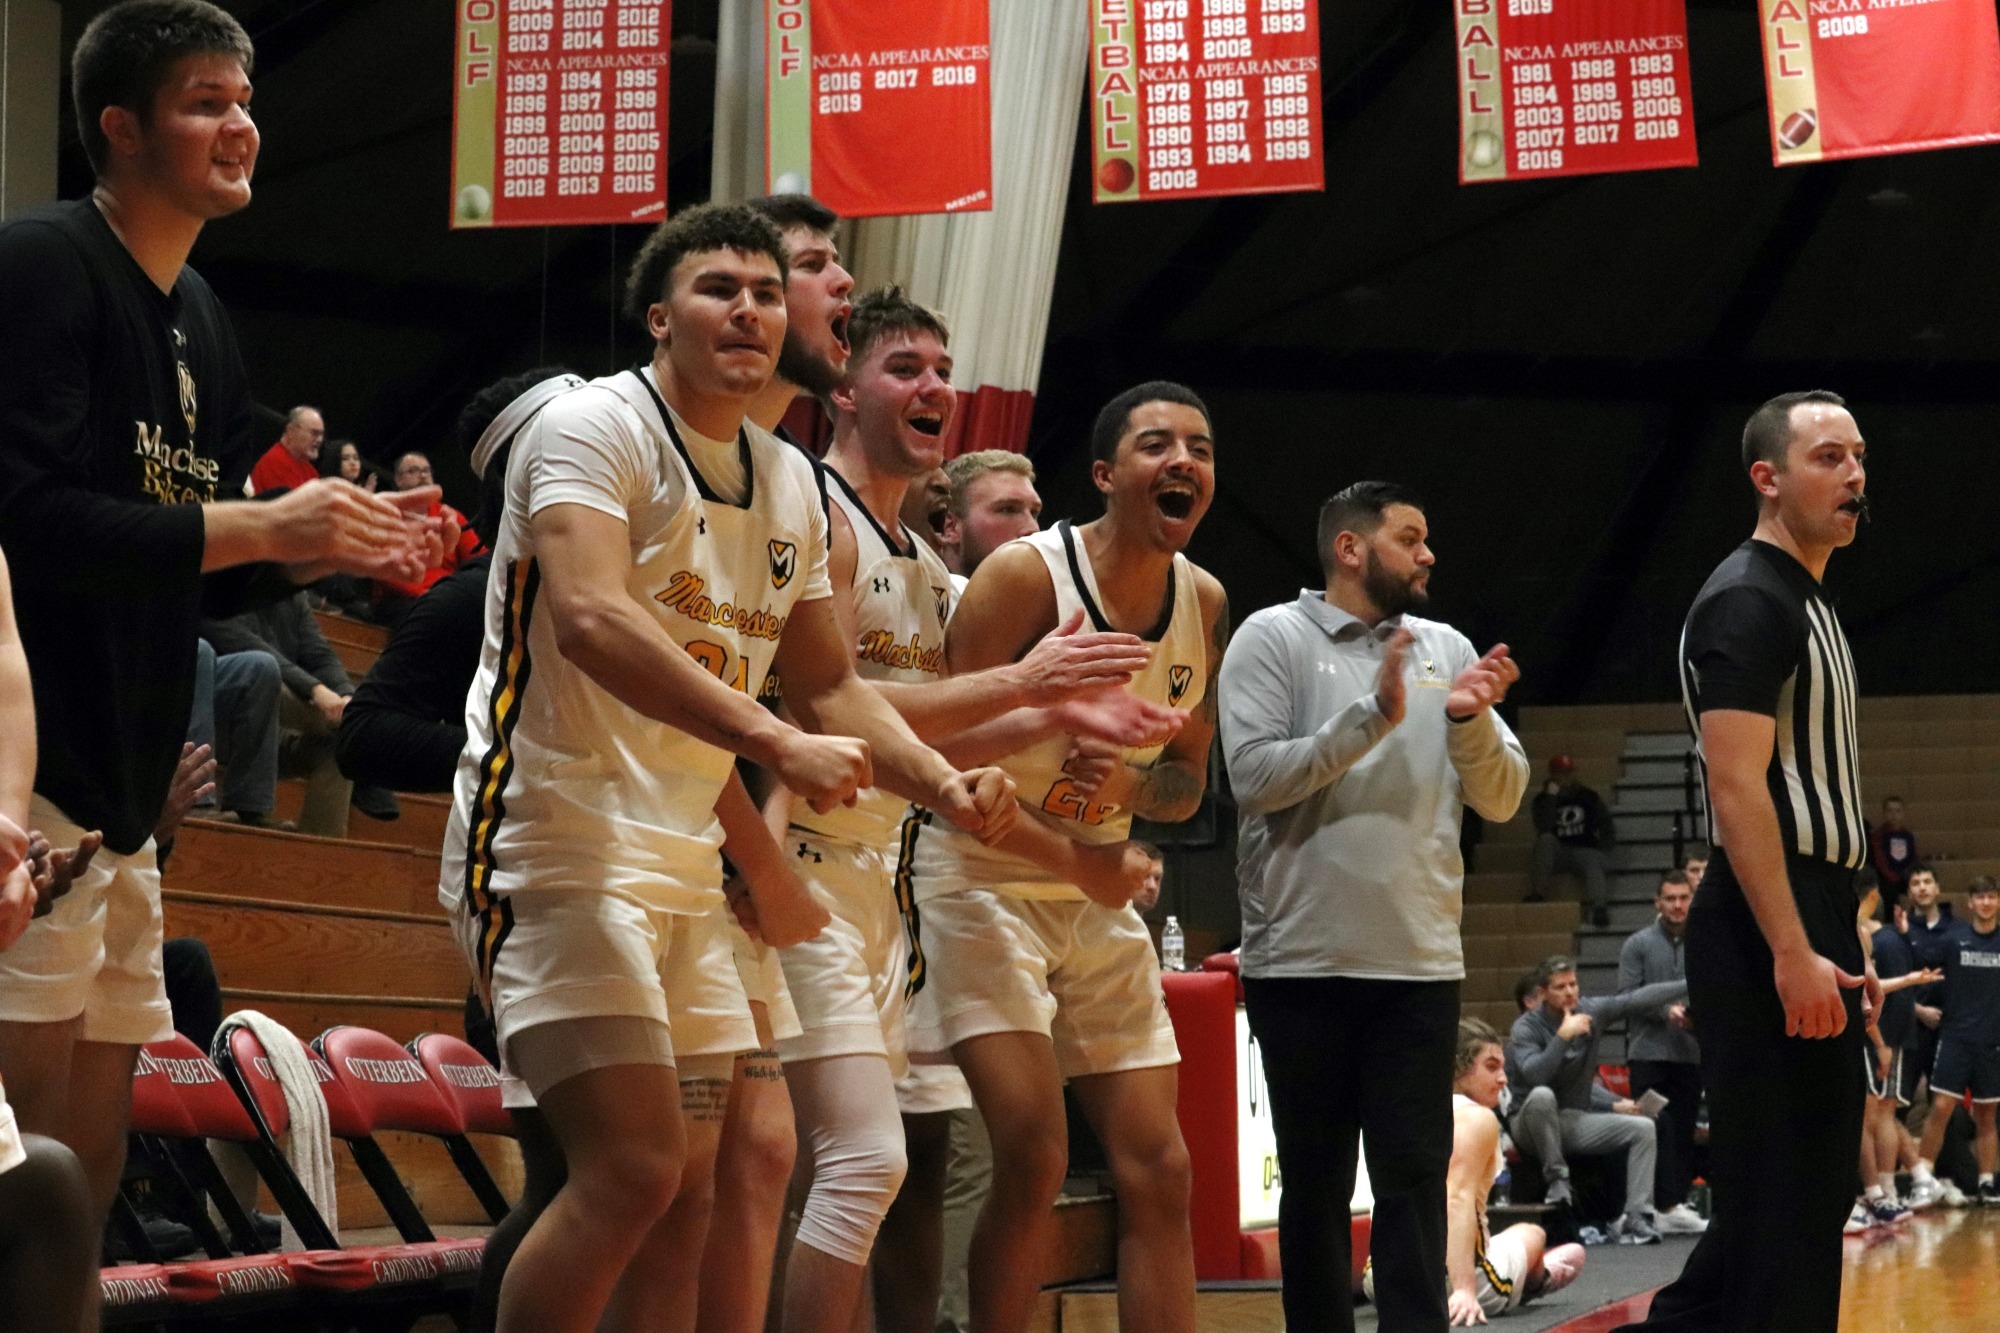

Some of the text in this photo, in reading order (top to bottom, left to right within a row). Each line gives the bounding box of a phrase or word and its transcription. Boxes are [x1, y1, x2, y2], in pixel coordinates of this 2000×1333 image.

[509, 8, 659, 32] 2009 2010 2012
[1144, 0, 1188, 20] 1978
[1203, 0, 1246, 16] 1986
[1810, 0, 1862, 15] NCAA
[1145, 13, 1306, 42] 1991 1992 1993
[1818, 14, 1868, 38] 2008
[508, 28, 658, 52] 2013 2014 2015
[1146, 38, 1252, 63] 1994 2002
[1504, 36, 1683, 62] NCAA APPEARANCES
[507, 53, 667, 72] NCAA APPEARANCES
[813, 44, 990, 69] NCAA APPEARANCES
[1512, 54, 1673, 84] 1981 1982 1983
[507, 69, 656, 92] 1993 1994 1995
[820, 65, 976, 92] 2016 2017 2018
[1139, 57, 1317, 82] NCAA APPEARANCES
[1147, 74, 1307, 103] 1978 1981 1985
[1514, 77, 1675, 106] 1984 1989 1990
[506, 90, 656, 113] 1996 1997 1998
[819, 93, 862, 114] 2019
[1148, 96, 1308, 125] 1986 1987 1989
[1514, 97, 1681, 127] 2003 2005 2006
[505, 111, 655, 134] 1999 2000 2001
[1148, 118, 1309, 147] 1990 1991 1992
[1516, 119, 1679, 149] 2007 2017 2018
[505, 132, 660, 155] 2002 2004 2005
[1149, 140, 1310, 168] 1993 1994 1999
[504, 153, 655, 176] 2006 2009 2010
[1518, 149, 1562, 170] 2019
[504, 174, 655, 197] 2012 2013 2015
[1149, 169, 1197, 190] 2002
[154, 1056, 222, 1084] TERBEIN
[344, 1056, 428, 1083] OTTERBEIN
[216, 1264, 291, 1296] CARDINALS
[372, 1255, 438, 1284] CARDINALS
[101, 1276, 169, 1306] ARDINALS
